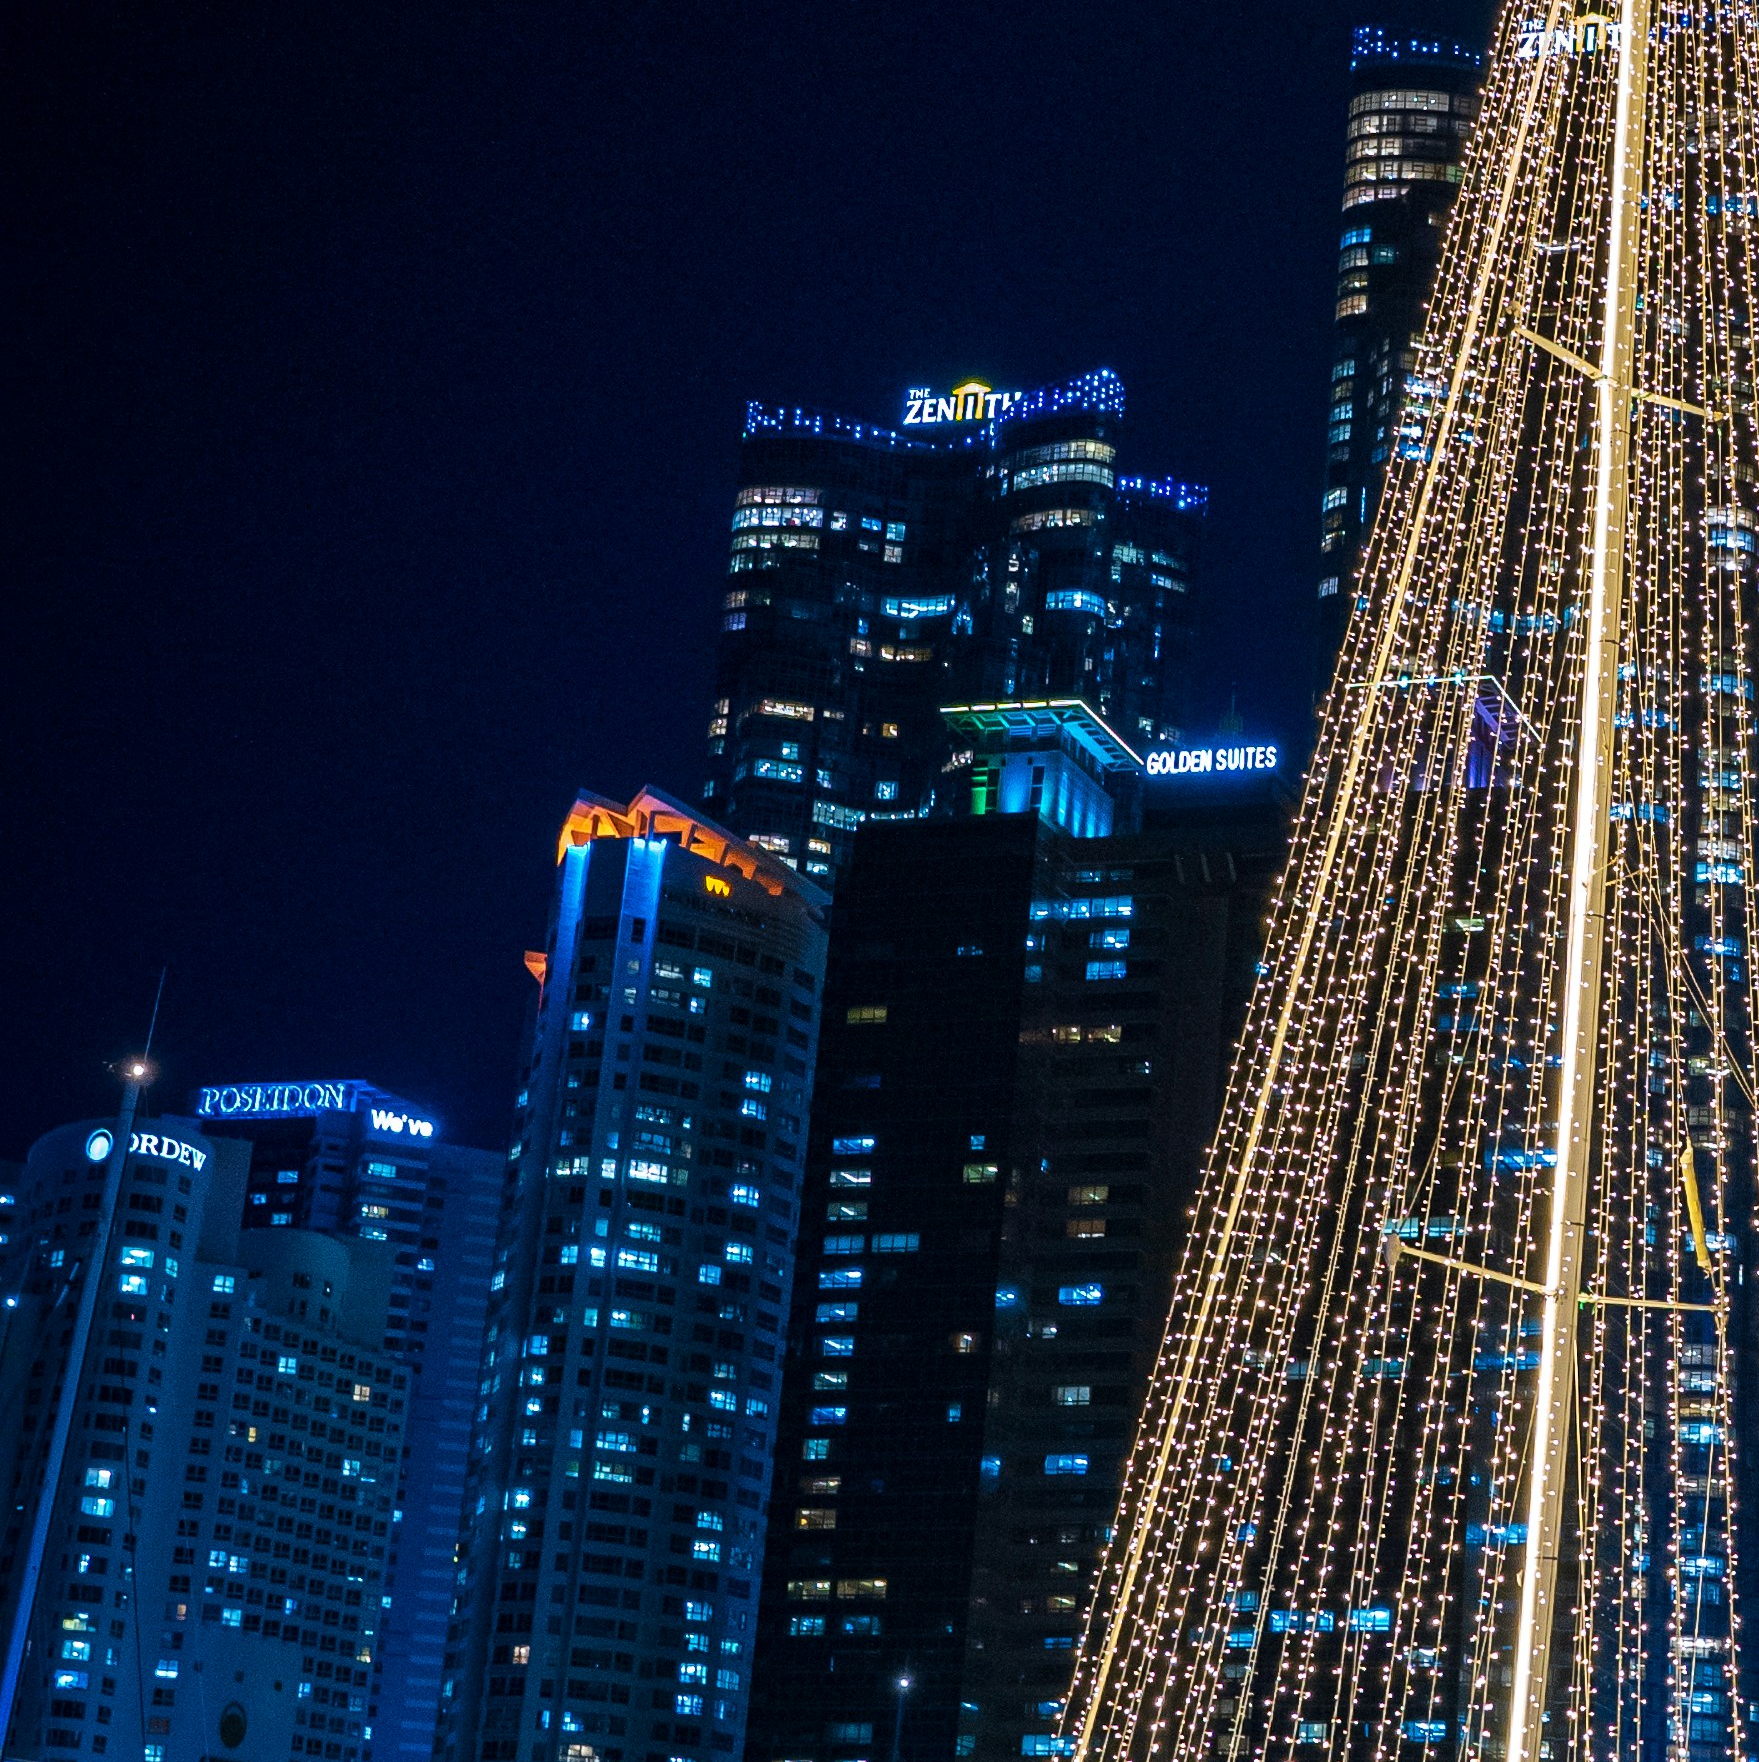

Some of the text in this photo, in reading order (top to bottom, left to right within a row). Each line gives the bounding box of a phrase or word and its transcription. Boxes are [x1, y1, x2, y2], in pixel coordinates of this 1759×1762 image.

[909, 389, 930, 399] THE
[1146, 746, 1277, 775] GOLDEN SUITES
[198, 1084, 345, 1114] POSEIDON
[371, 1109, 433, 1137] We've
